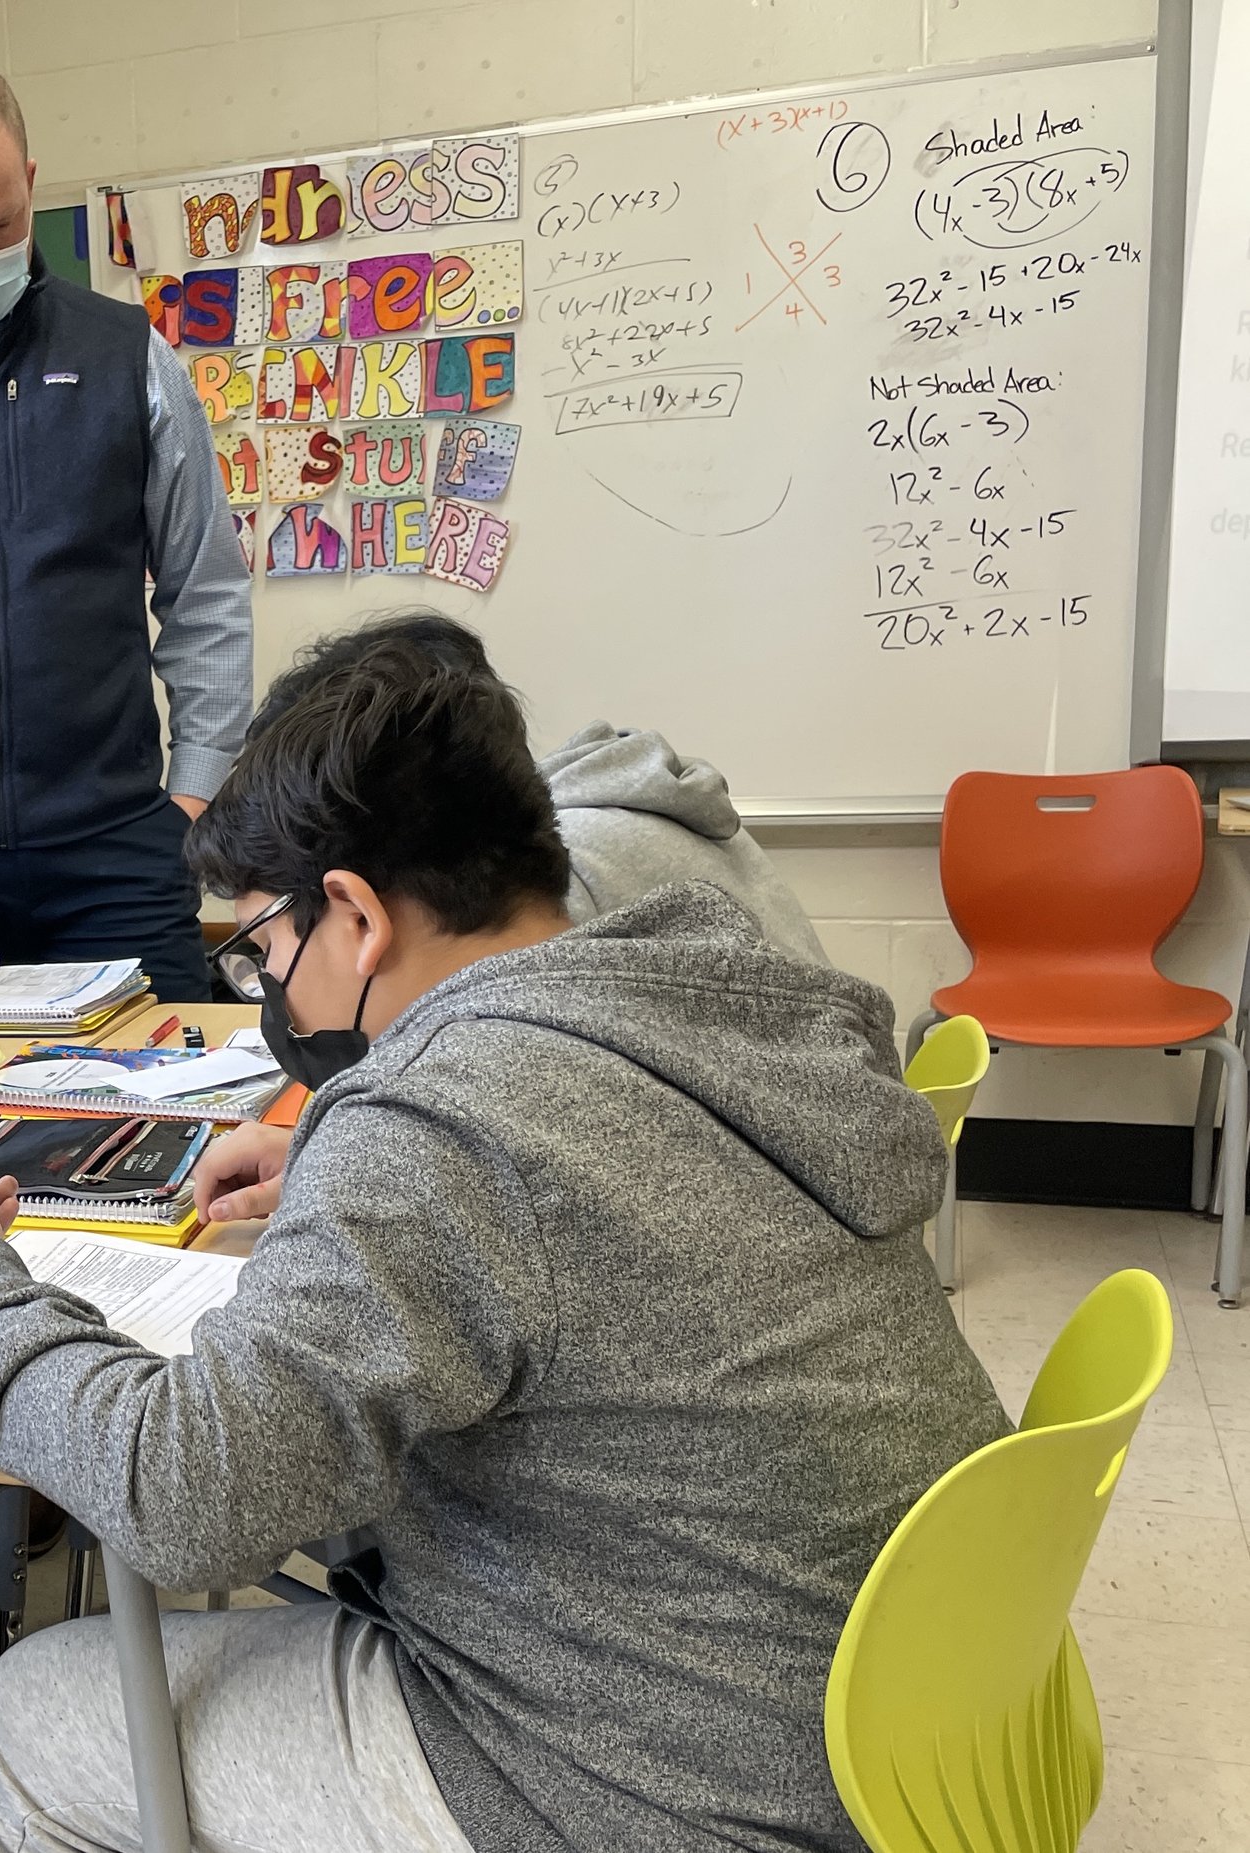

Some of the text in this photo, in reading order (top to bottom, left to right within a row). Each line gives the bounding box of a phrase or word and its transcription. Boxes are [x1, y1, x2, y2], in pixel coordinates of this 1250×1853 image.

[924, 113, 1024, 165] Shaded
[870, 366, 1064, 401] Not Shaded Area:
